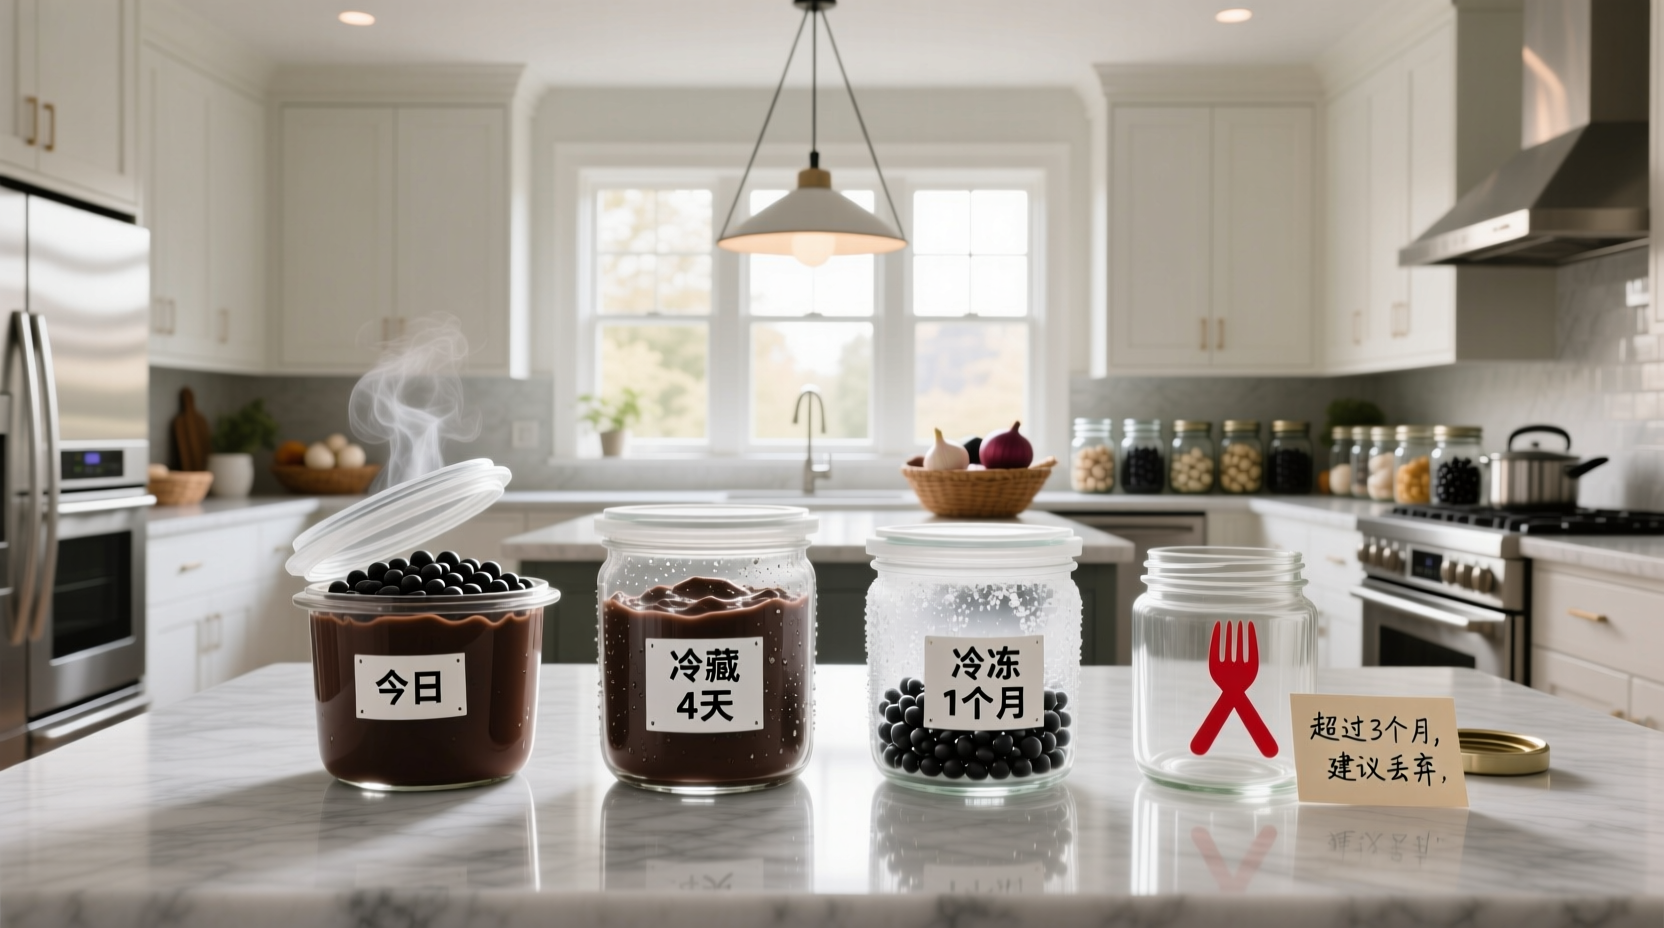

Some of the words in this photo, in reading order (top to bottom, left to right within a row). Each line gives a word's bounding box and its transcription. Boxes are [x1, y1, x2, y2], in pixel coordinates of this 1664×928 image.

[669, 647, 741, 684] 冷藏
[951, 645, 1021, 681] 冷冻
[375, 669, 442, 706] 今日
[676, 689, 734, 722] 4天
[942, 685, 1025, 720] 1个月
